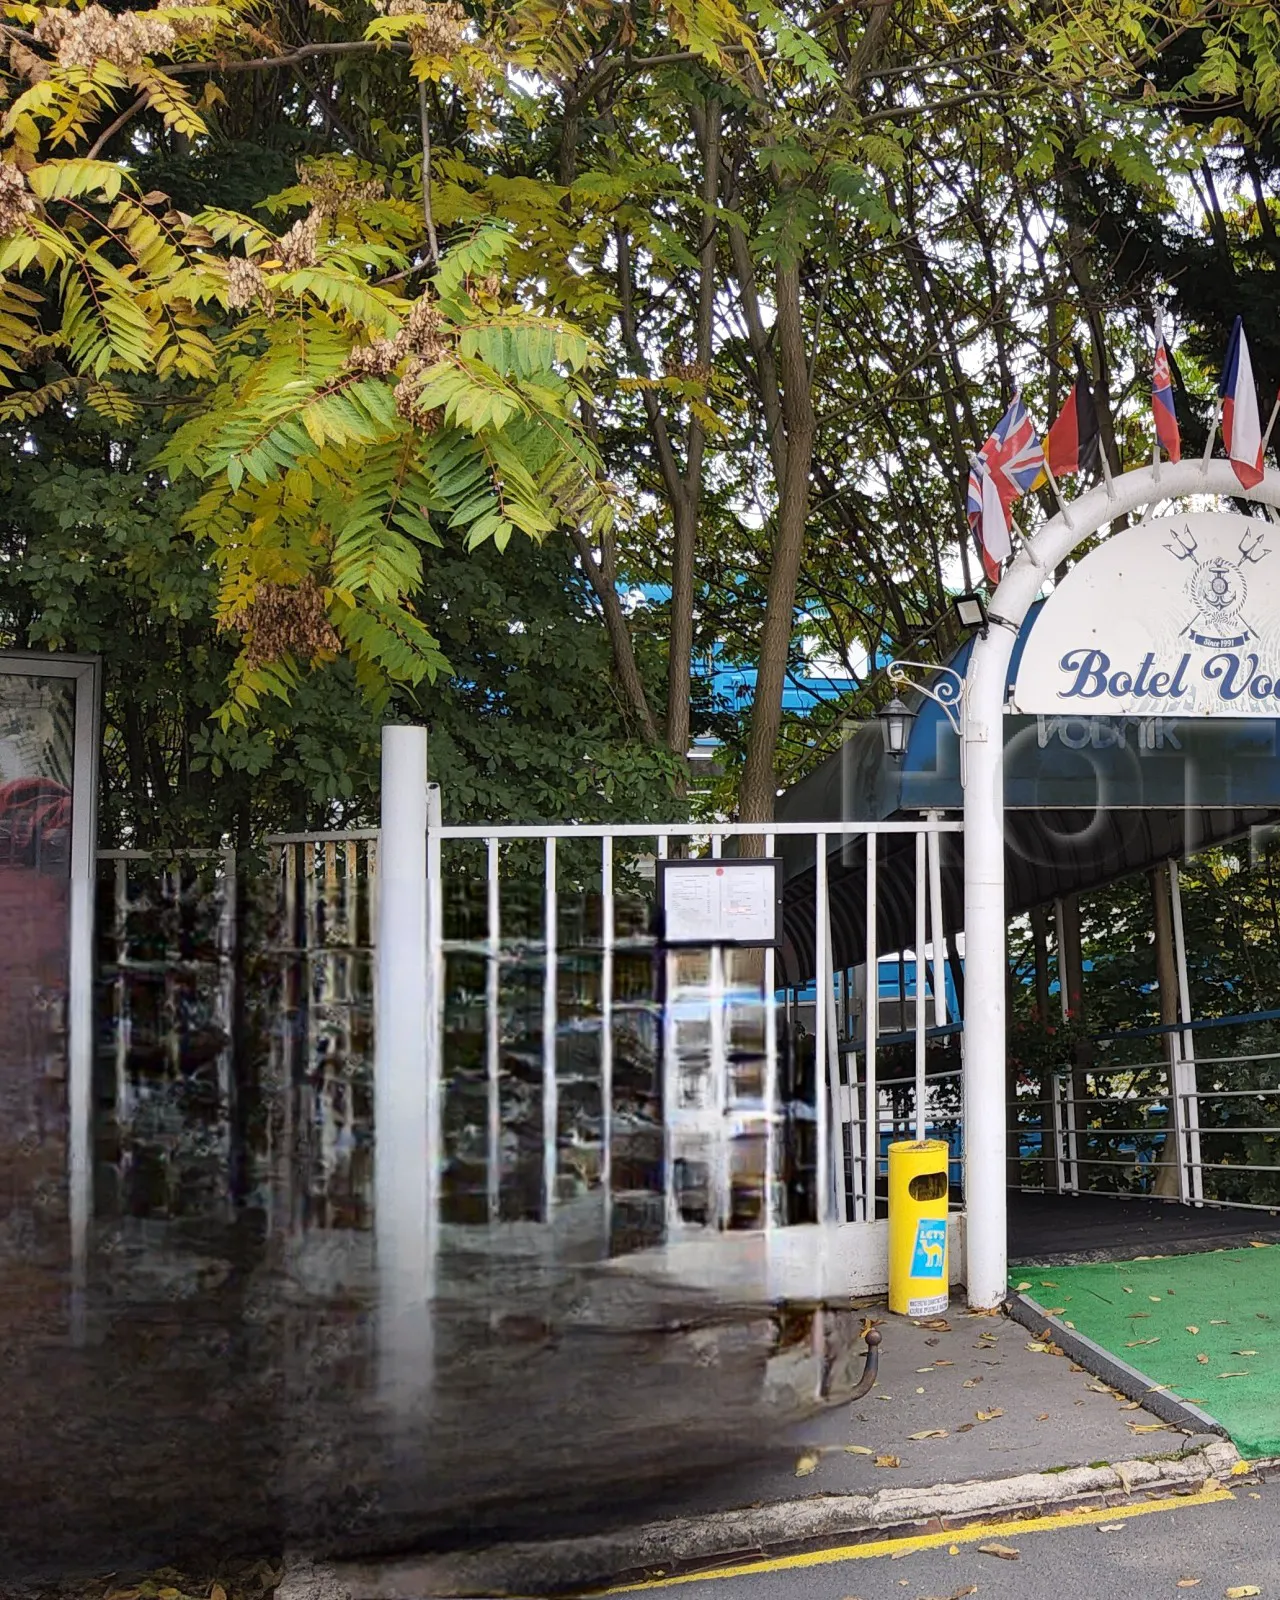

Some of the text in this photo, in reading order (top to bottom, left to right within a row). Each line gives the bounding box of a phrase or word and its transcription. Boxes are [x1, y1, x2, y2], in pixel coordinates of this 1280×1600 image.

[1203, 638, 1235, 648] Since 1991
[1056, 649, 1192, 698] Botel
